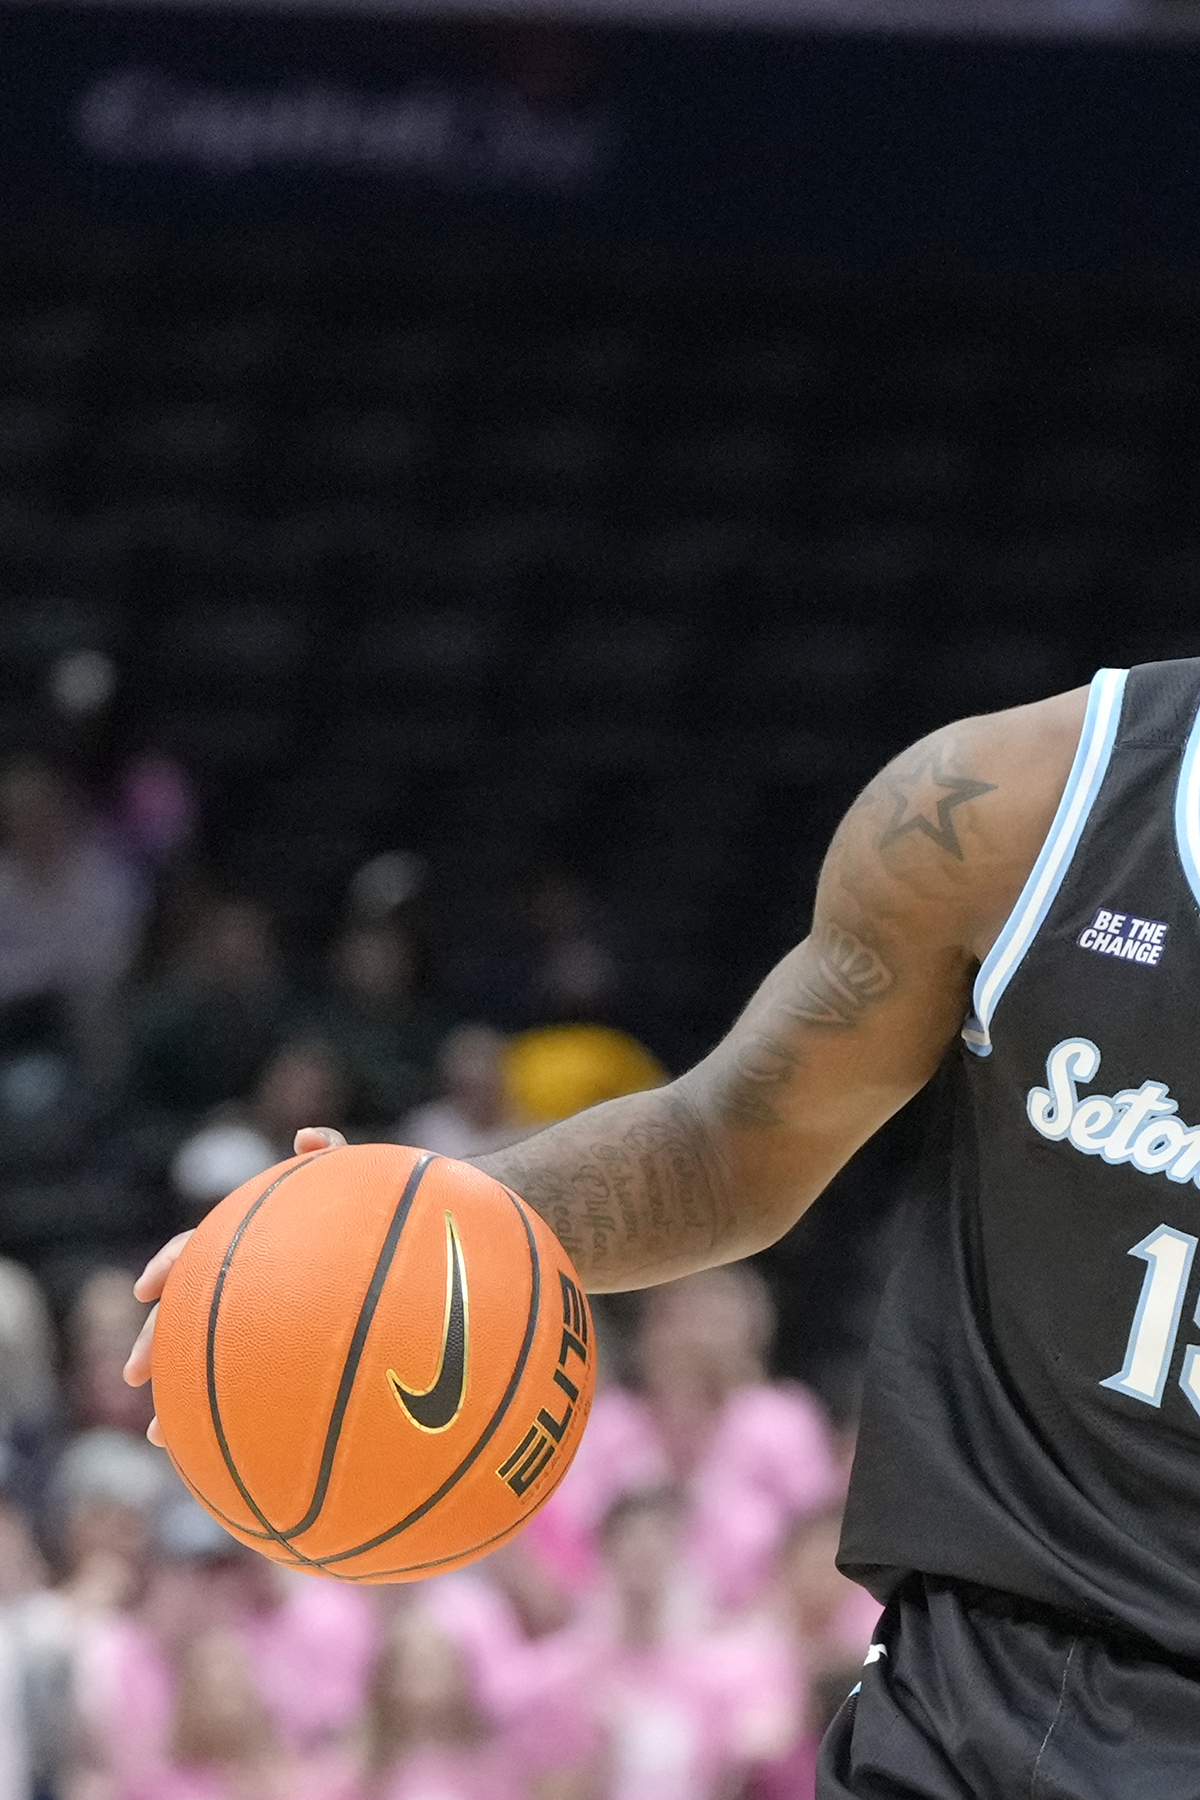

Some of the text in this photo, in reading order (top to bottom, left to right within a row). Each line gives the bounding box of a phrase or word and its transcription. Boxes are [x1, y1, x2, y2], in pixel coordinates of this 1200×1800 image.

[1093, 910, 1167, 944] BE THE
[1079, 928, 1163, 965] CHANGE
[494, 1269, 588, 1498] ELITE
